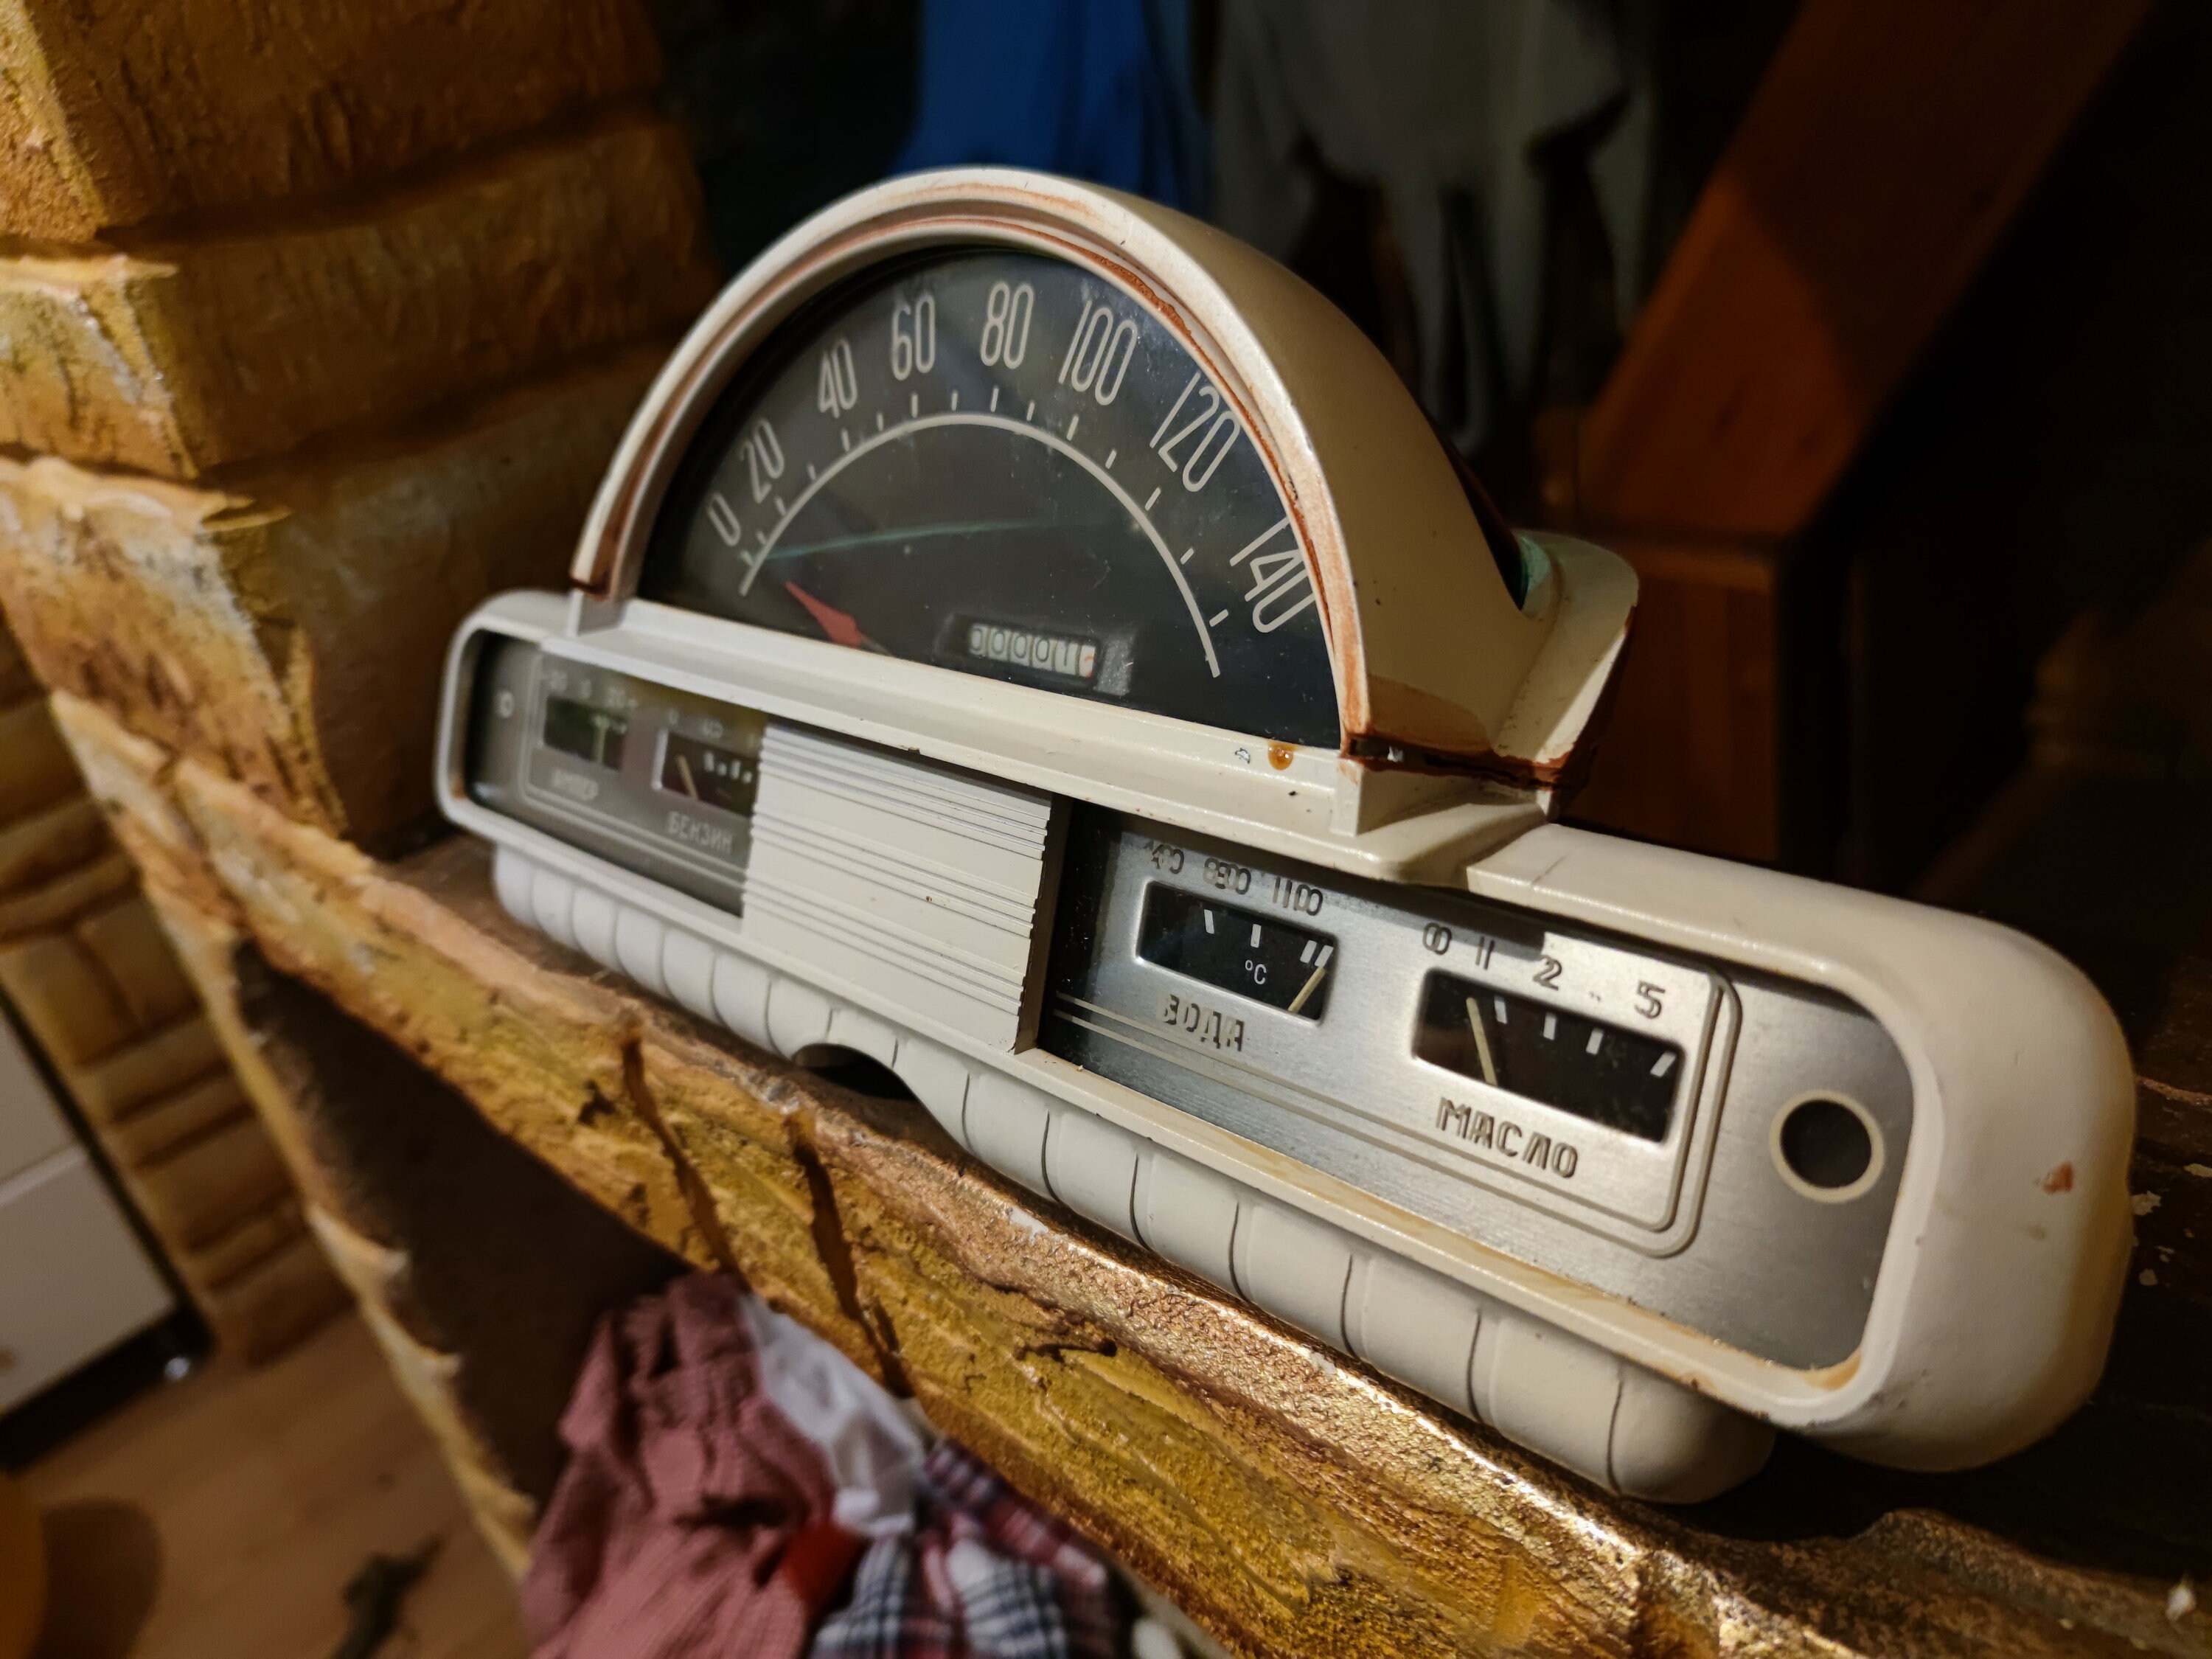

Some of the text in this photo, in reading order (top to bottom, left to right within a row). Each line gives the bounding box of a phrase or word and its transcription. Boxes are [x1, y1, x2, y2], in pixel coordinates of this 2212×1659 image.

[707, 282, 1316, 633] 0 20 40 60 80 100 120 140
[1532, 954, 1562, 990] 2
[1634, 980, 1666, 1020] 5
[1435, 1096, 1579, 1178] МАСЛО
